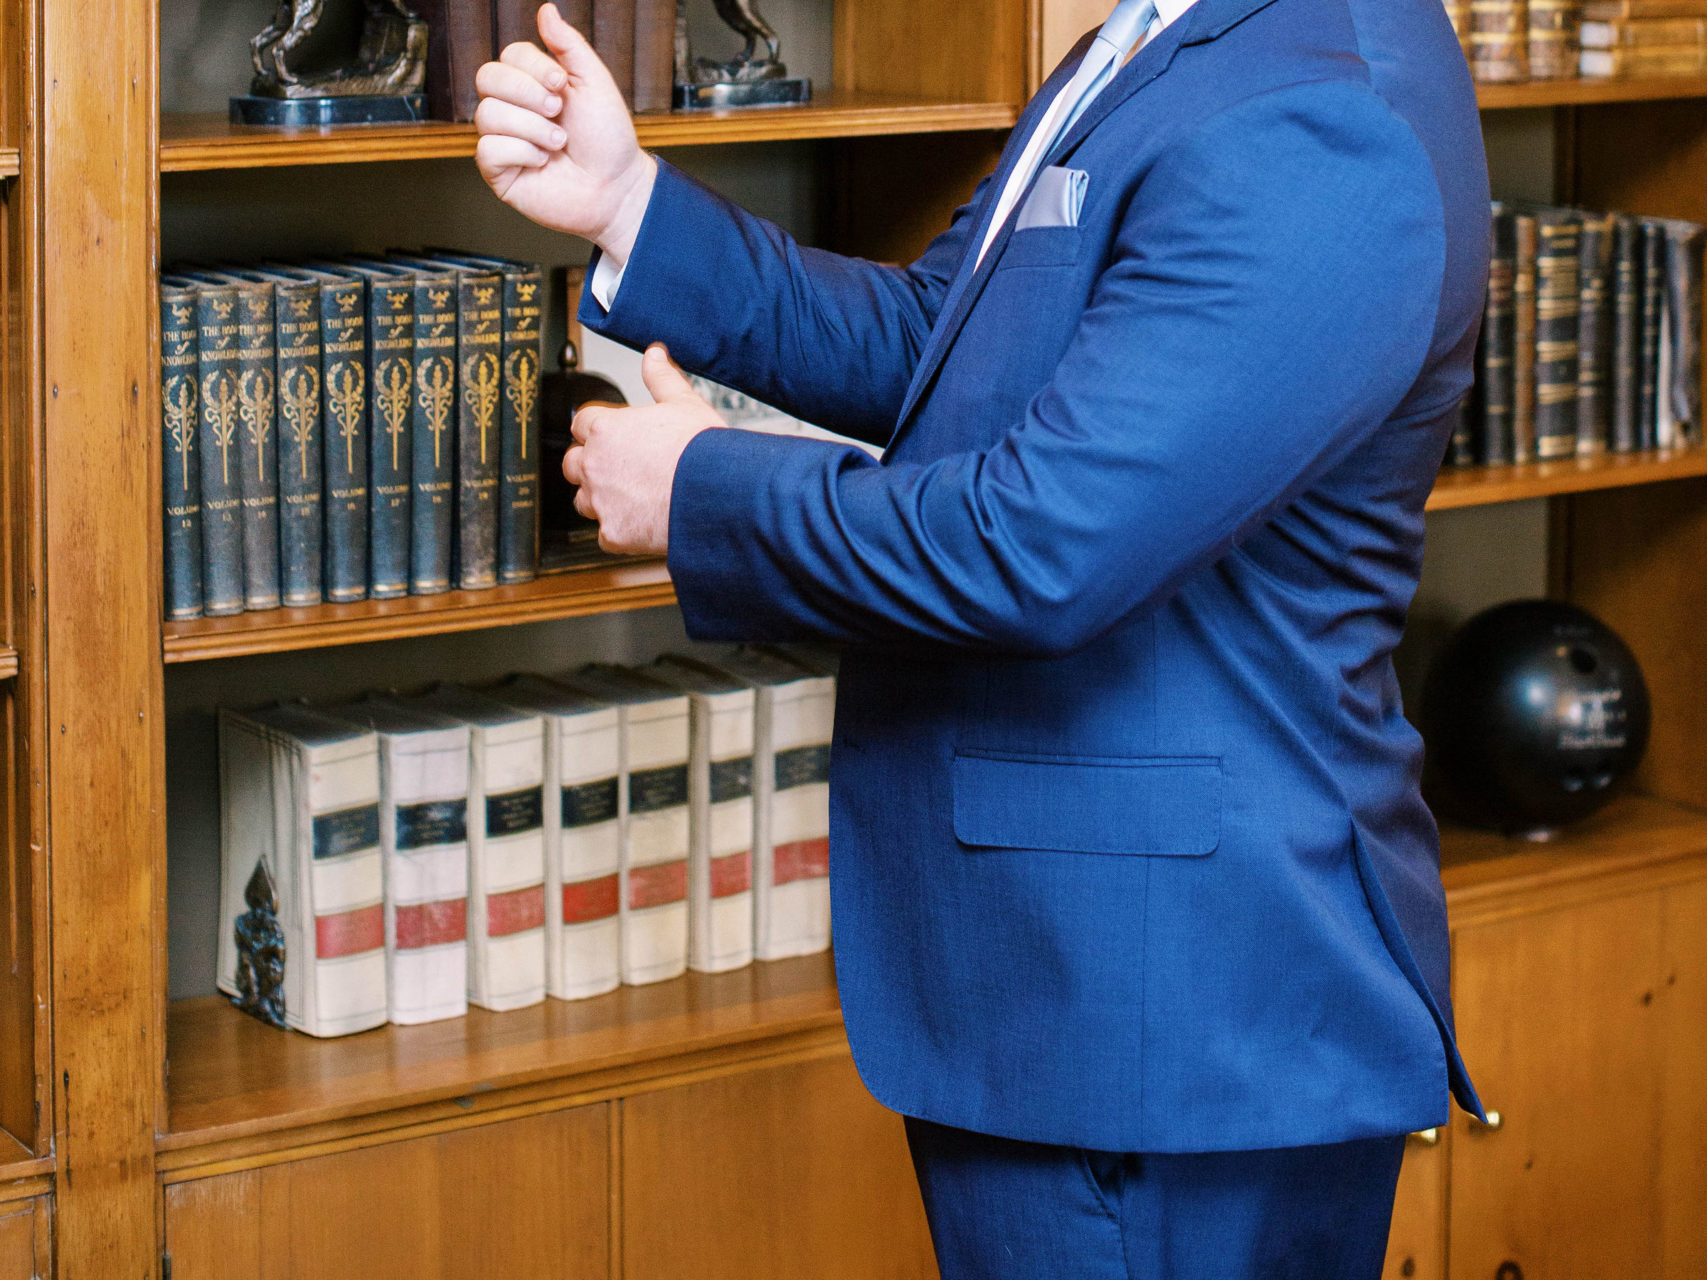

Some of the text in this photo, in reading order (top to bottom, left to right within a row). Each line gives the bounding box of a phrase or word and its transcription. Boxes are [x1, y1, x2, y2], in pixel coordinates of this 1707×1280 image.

[464, 311, 479, 322] THE
[507, 308, 522, 317] THE
[326, 319, 343, 329] THE
[376, 315, 393, 326] THE
[418, 314, 435, 325] THE
[202, 326, 219, 337] THE
[239, 325, 255, 336] THE
[280, 323, 297, 334] THE
[163, 332, 179, 342] THE
